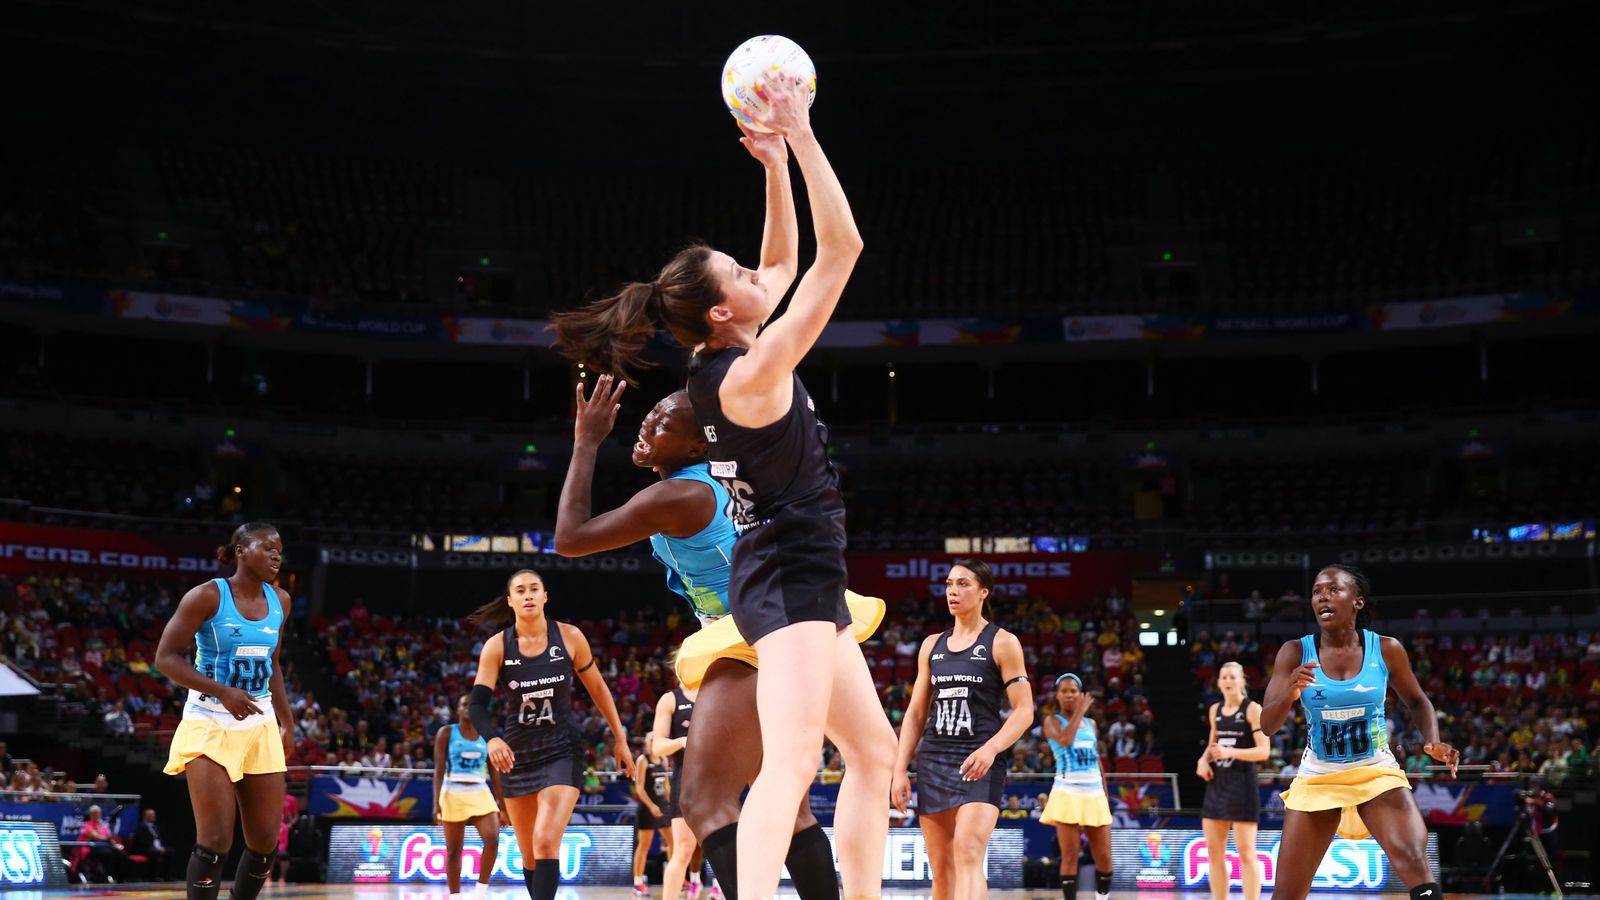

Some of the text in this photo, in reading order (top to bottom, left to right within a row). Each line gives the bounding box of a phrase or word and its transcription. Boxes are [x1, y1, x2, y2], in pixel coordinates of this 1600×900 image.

[0, 544, 220, 572] rena.com.au
[885, 558, 1072, 582] allpnes
[520, 674, 565, 688] NEW WORLD
[937, 674, 983, 683] NEW WORLD
[519, 699, 556, 725] GA
[935, 700, 974, 736] WA
[1324, 709, 1363, 719] TELSTRA
[1321, 720, 1370, 756] WD
